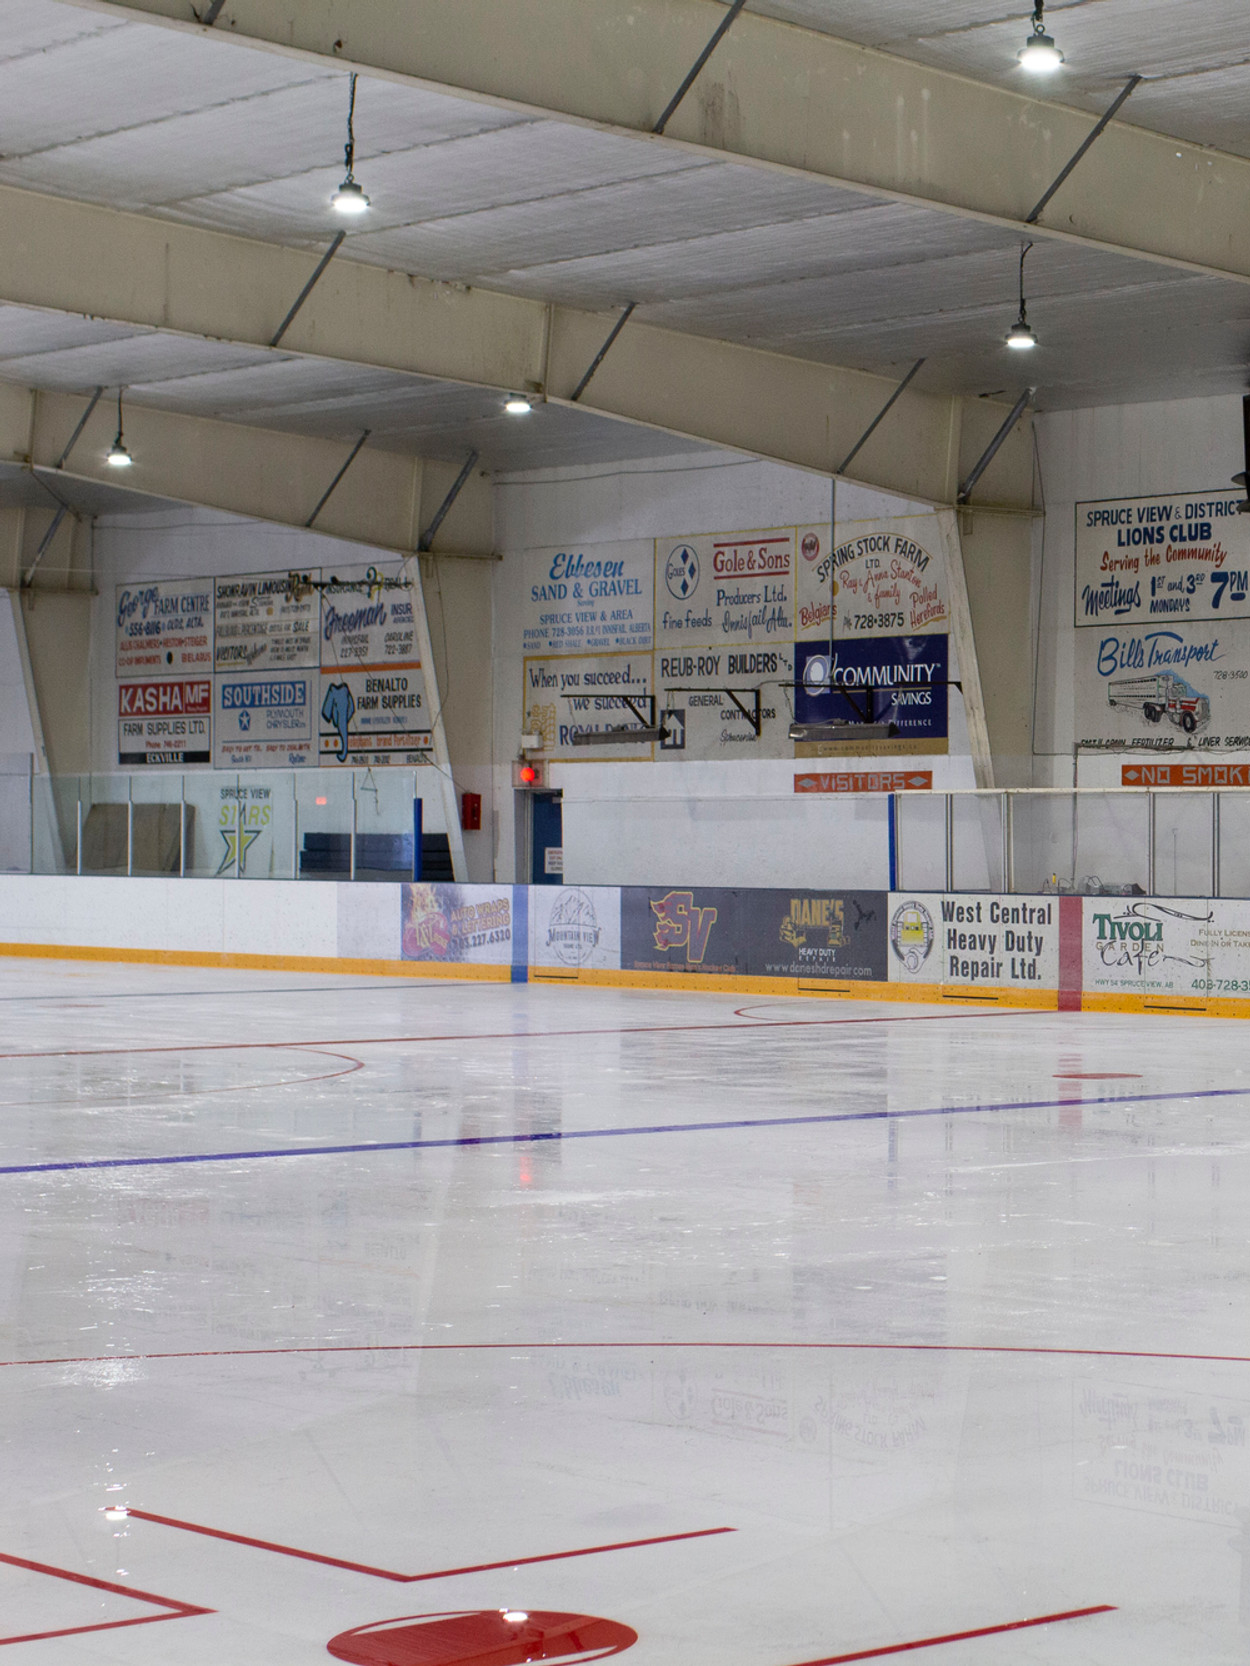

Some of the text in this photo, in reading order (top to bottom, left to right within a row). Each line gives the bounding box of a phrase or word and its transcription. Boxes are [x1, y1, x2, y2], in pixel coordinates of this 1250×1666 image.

[1086, 508, 1132, 527] SPRUCE
[1137, 505, 1173, 523] VIEW
[1117, 522, 1212, 547] LIONS CLUB
[713, 547, 790, 573] Gole & Sons
[817, 536, 930, 583] SPRING STOCK FARM
[1100, 542, 1227, 574] Serving the Community
[531, 579, 642, 602] SAND & GRAVEL
[716, 584, 787, 606] Producers Ltd.
[1082, 574, 1142, 616] Meetings
[181, 595, 209, 612] CENTRE
[1150, 598, 1190, 614] MONDAYS
[575, 612, 597, 623] VIEW
[610, 609, 633, 620] AREA
[663, 608, 712, 629] fine feeds
[1144, 631, 1226, 668] Transport
[728, 653, 777, 675] BUILDERS
[833, 663, 935, 687] COMMUNITY
[366, 678, 408, 693] BENALTO
[529, 668, 579, 691] When you
[121, 683, 210, 713] KASHA MF
[223, 683, 305, 707] SOUTHSIDE
[357, 694, 421, 710] FARM SUPPLIES
[573, 697, 590, 711] we
[688, 695, 723, 706] GENERAL
[891, 692, 932, 706] SAVINGS
[124, 723, 144, 736] FARM
[147, 721, 186, 735] SUPPLIES
[1141, 767, 1170, 784] NO
[251, 788, 271, 799] VIEW
[451, 897, 510, 922] AUTO WRAPS
[790, 898, 844, 926] DANE'S
[941, 901, 1052, 925] West Central
[462, 912, 510, 934] LETTERING
[1092, 913, 1164, 941] TIVOLI
[947, 928, 1043, 956] Heavy Duty
[950, 955, 1041, 981] Repair Ltd.
